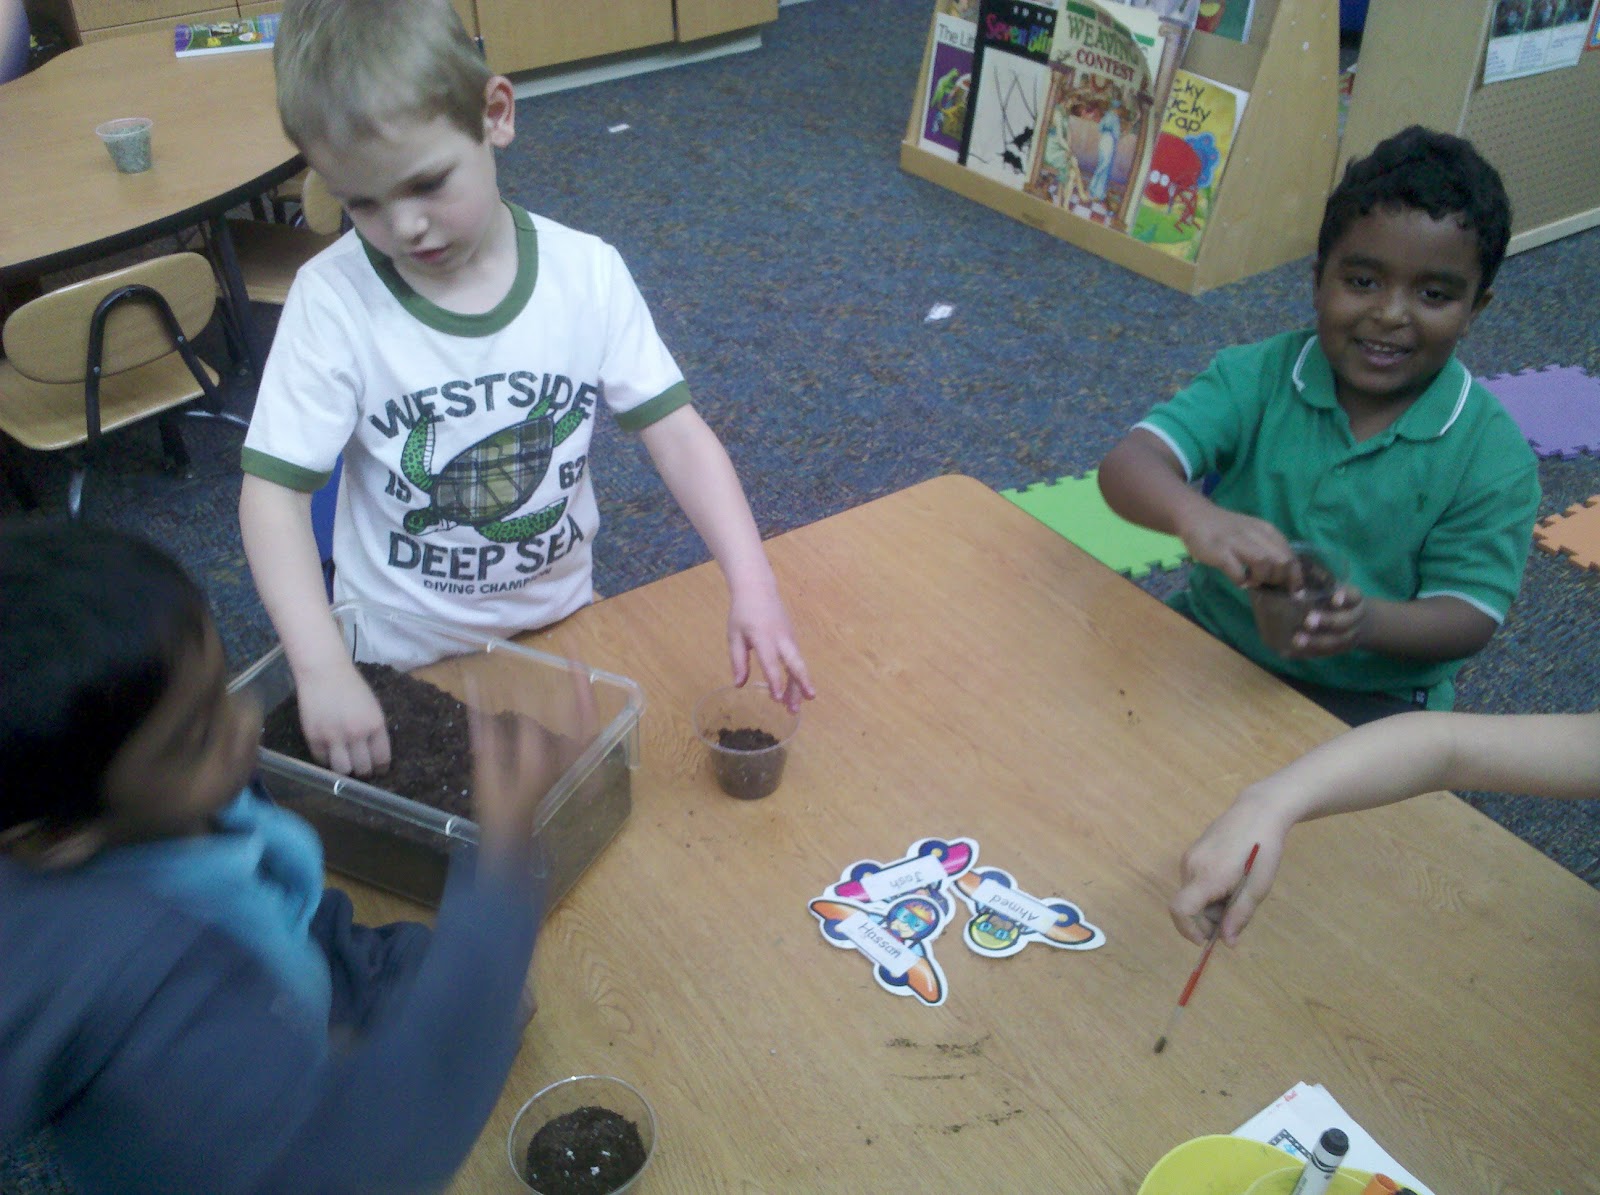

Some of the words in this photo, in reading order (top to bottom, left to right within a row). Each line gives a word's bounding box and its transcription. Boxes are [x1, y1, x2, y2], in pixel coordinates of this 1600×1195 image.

[1076, 48, 1135, 82] CONTEST
[368, 370, 598, 440] WESTSIDE
[387, 530, 506, 581] DEEP
[515, 513, 585, 575] SEA
[423, 579, 475, 595] DIVING
[889, 871, 924, 888] Josh
[988, 894, 1040, 921] Ahmed
[857, 921, 902, 959] Hassan
